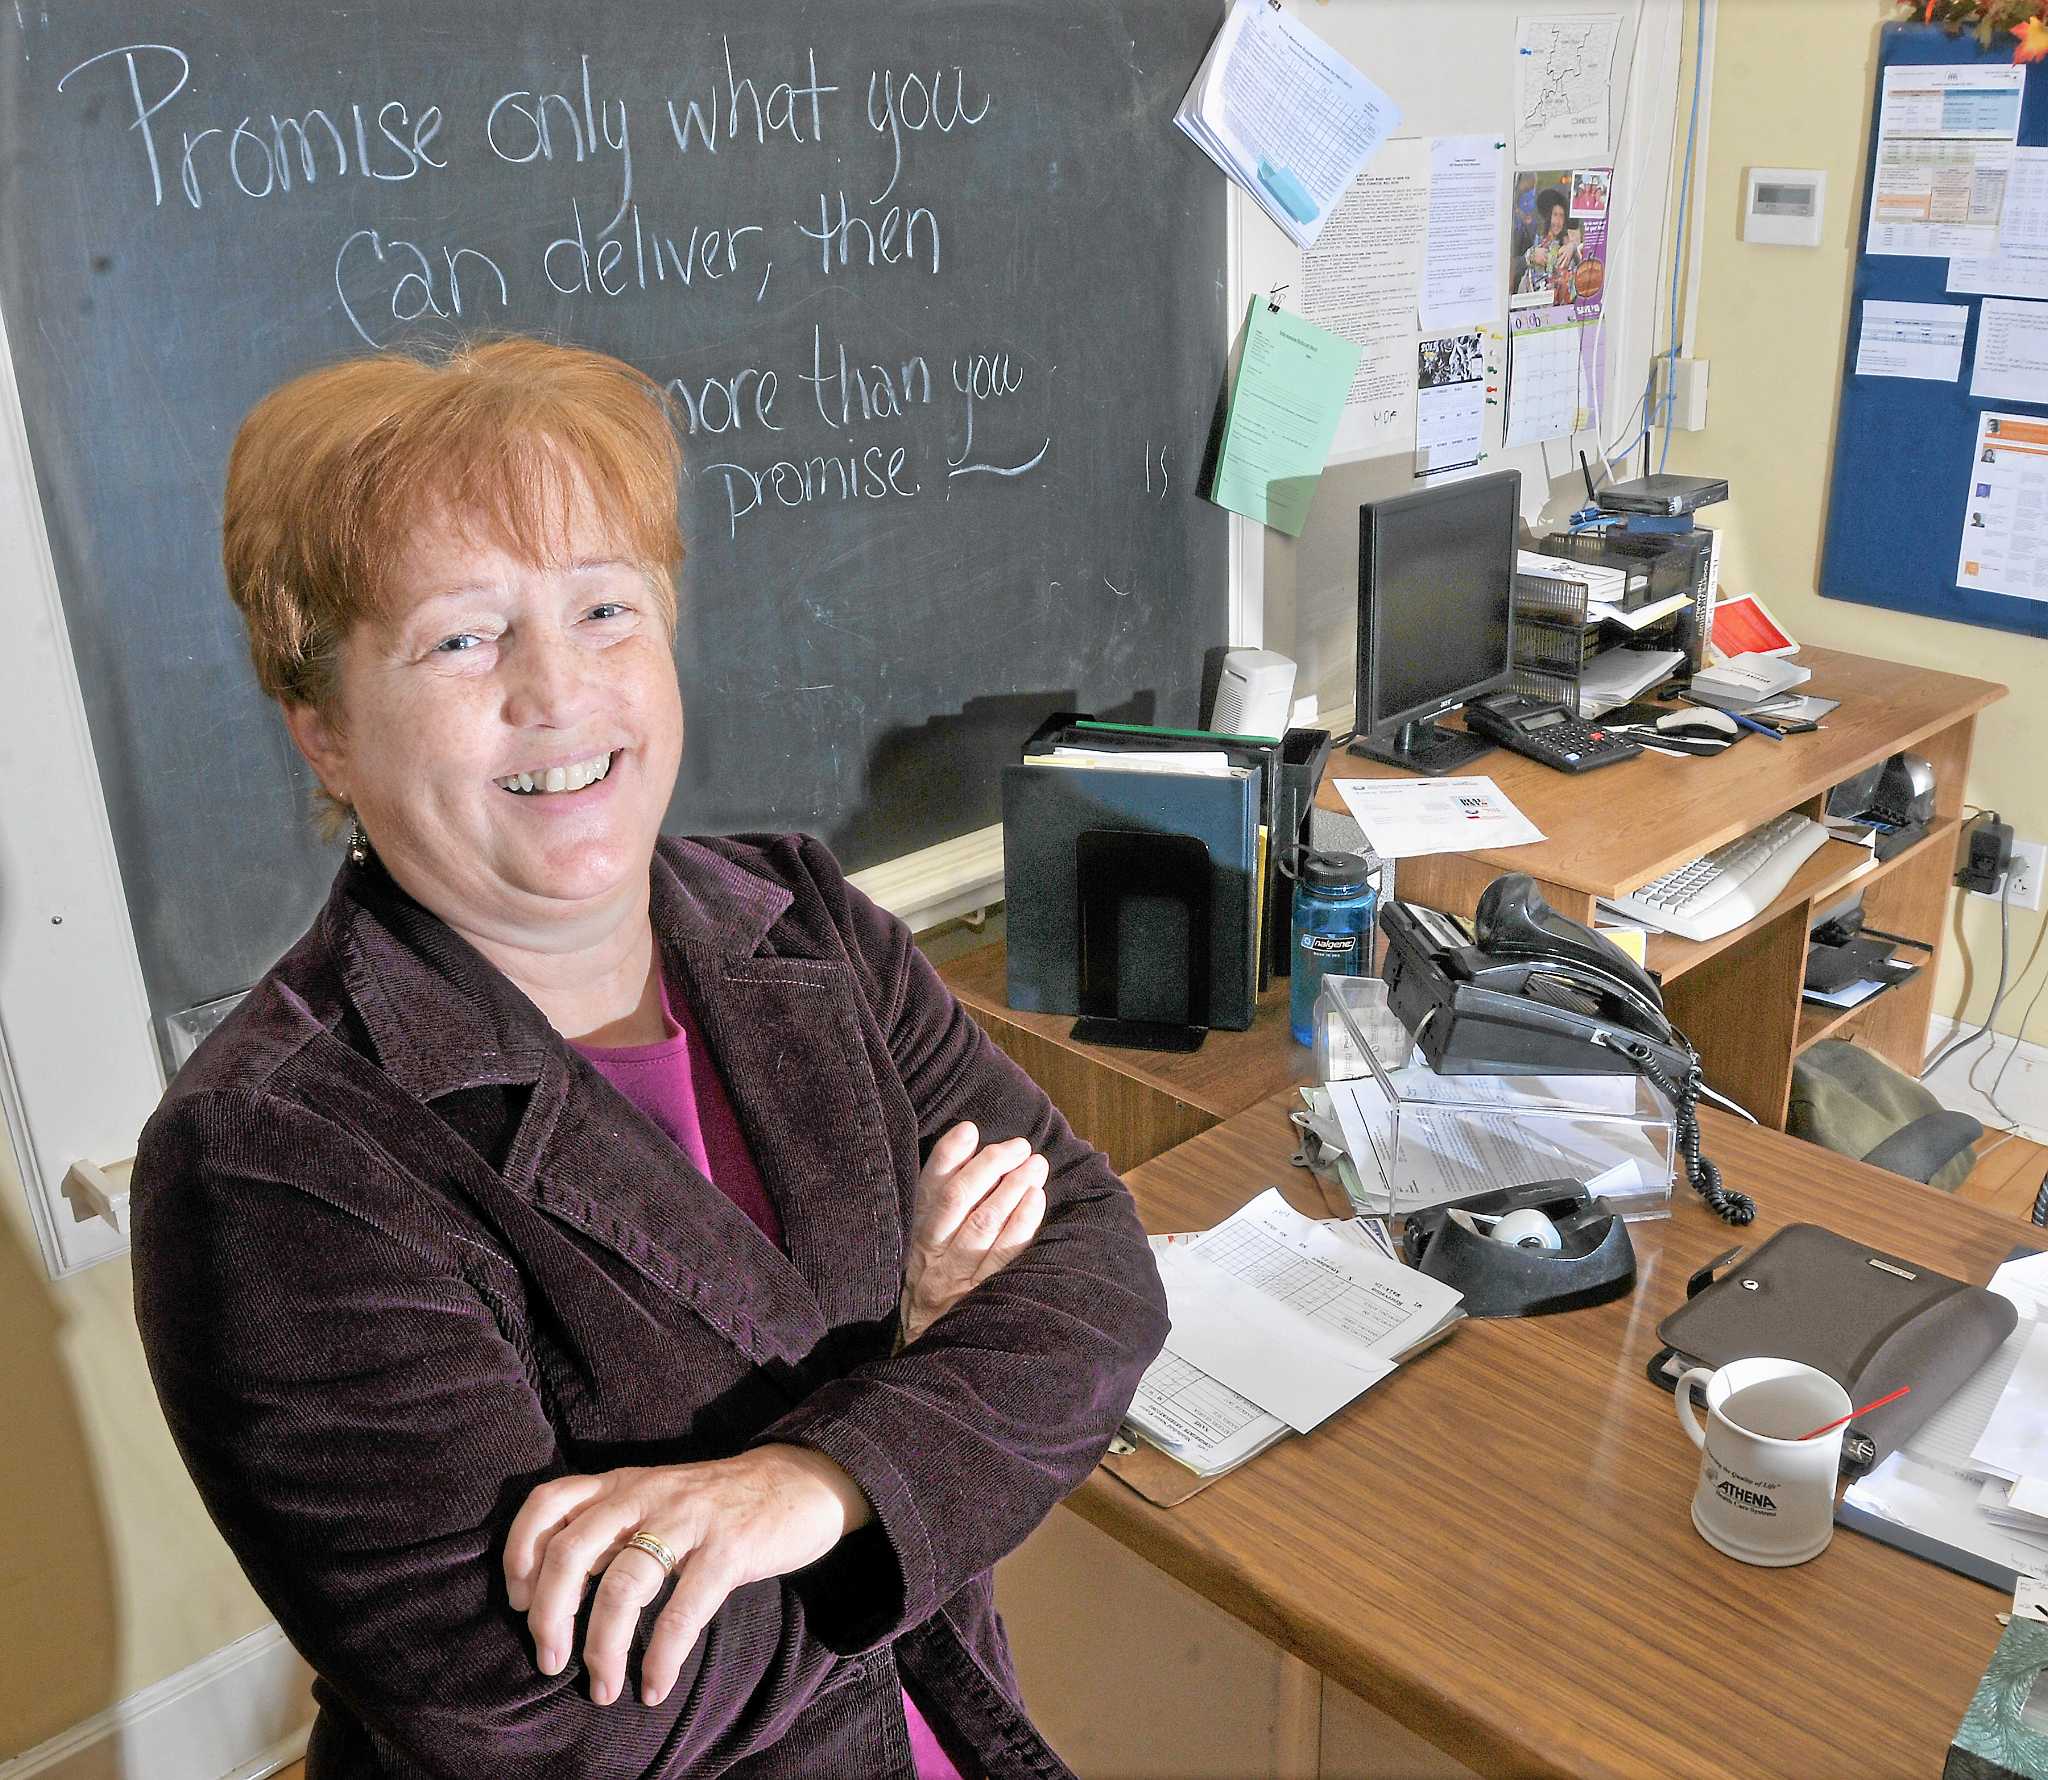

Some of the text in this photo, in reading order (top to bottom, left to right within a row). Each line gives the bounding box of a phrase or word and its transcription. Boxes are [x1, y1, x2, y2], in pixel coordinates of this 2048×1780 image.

[57, 33, 991, 241] Promise only what you
[543, 197, 772, 302] deliver,
[798, 190, 939, 275] then
[799, 323, 931, 428] than
[952, 352, 1024, 467] you
[701, 444, 923, 540] promise.
[1314, 939, 1353, 950] nalgene
[1717, 1480, 1777, 1509] ATHENA
